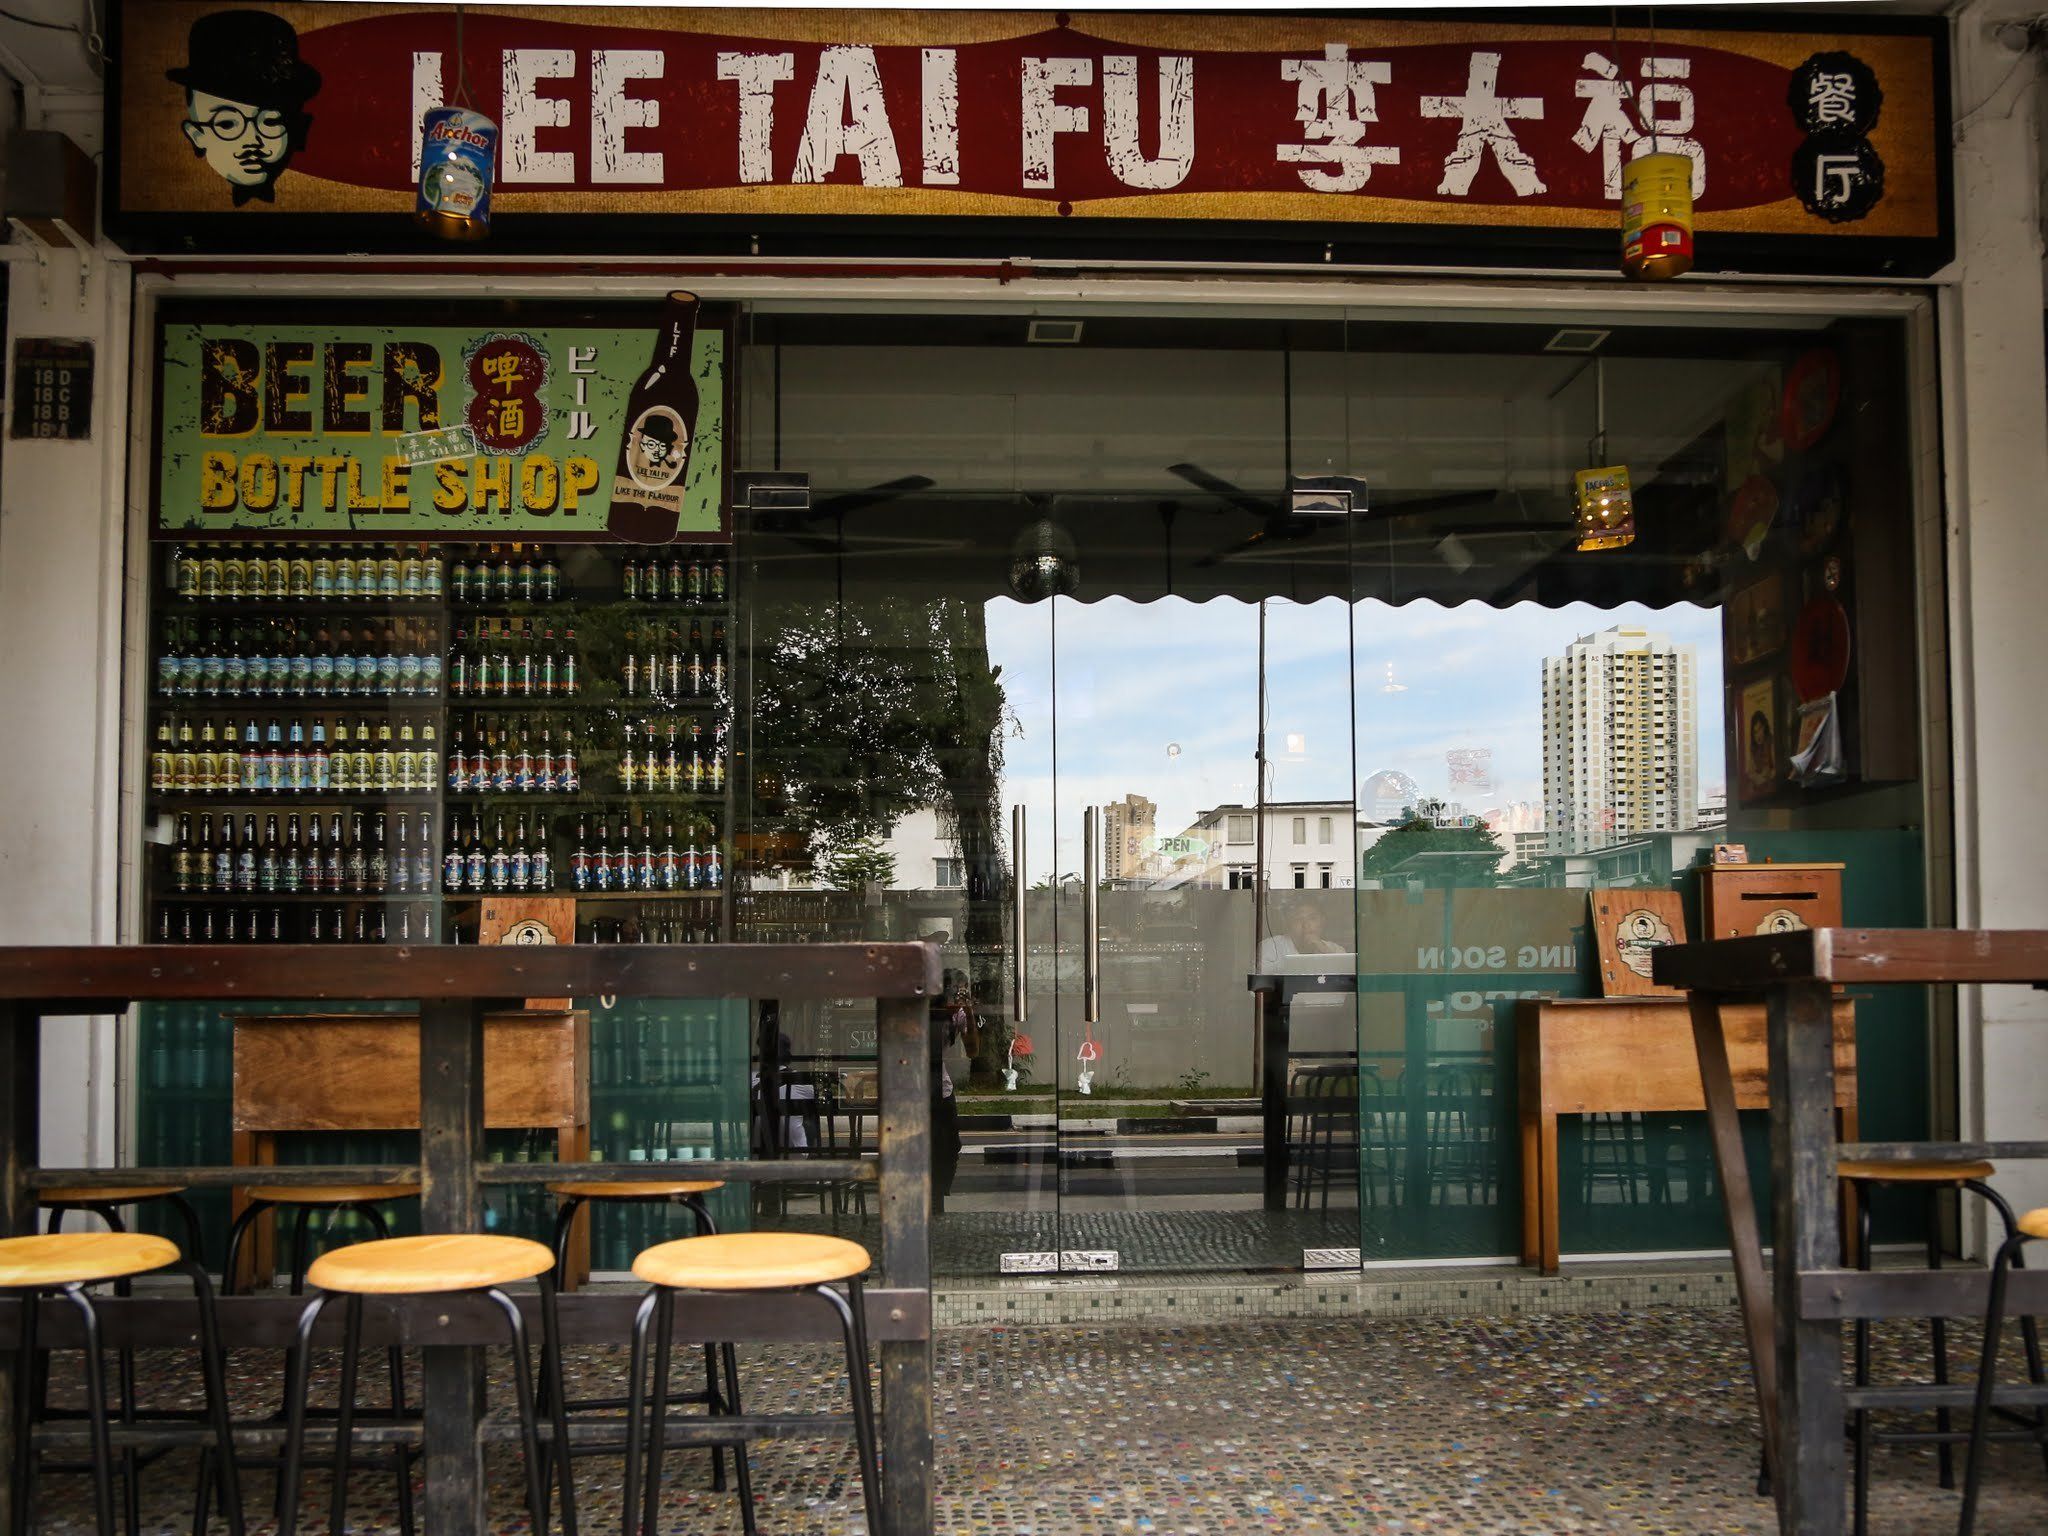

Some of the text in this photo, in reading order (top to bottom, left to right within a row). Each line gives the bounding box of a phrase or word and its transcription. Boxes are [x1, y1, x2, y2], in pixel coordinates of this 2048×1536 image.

[428, 120, 490, 149] Anchor
[717, 44, 960, 188] TAI
[1021, 55, 1195, 190] FU
[1276, 43, 1706, 201] 李大福
[1808, 72, 1860, 203] 餐厅
[669, 321, 681, 358] LTF
[34, 369, 71, 385] 18 D
[34, 387, 71, 403] 18 C
[201, 339, 445, 437] BEER
[483, 351, 524, 439] 啤酒
[566, 346, 598, 440] ビール
[32, 422, 51, 438] 18
[33, 404, 70, 420] 18 B
[201, 451, 599, 516] BOTTLE SHOP
[615, 486, 630, 495] LIKE
[633, 489, 647, 497] THE
